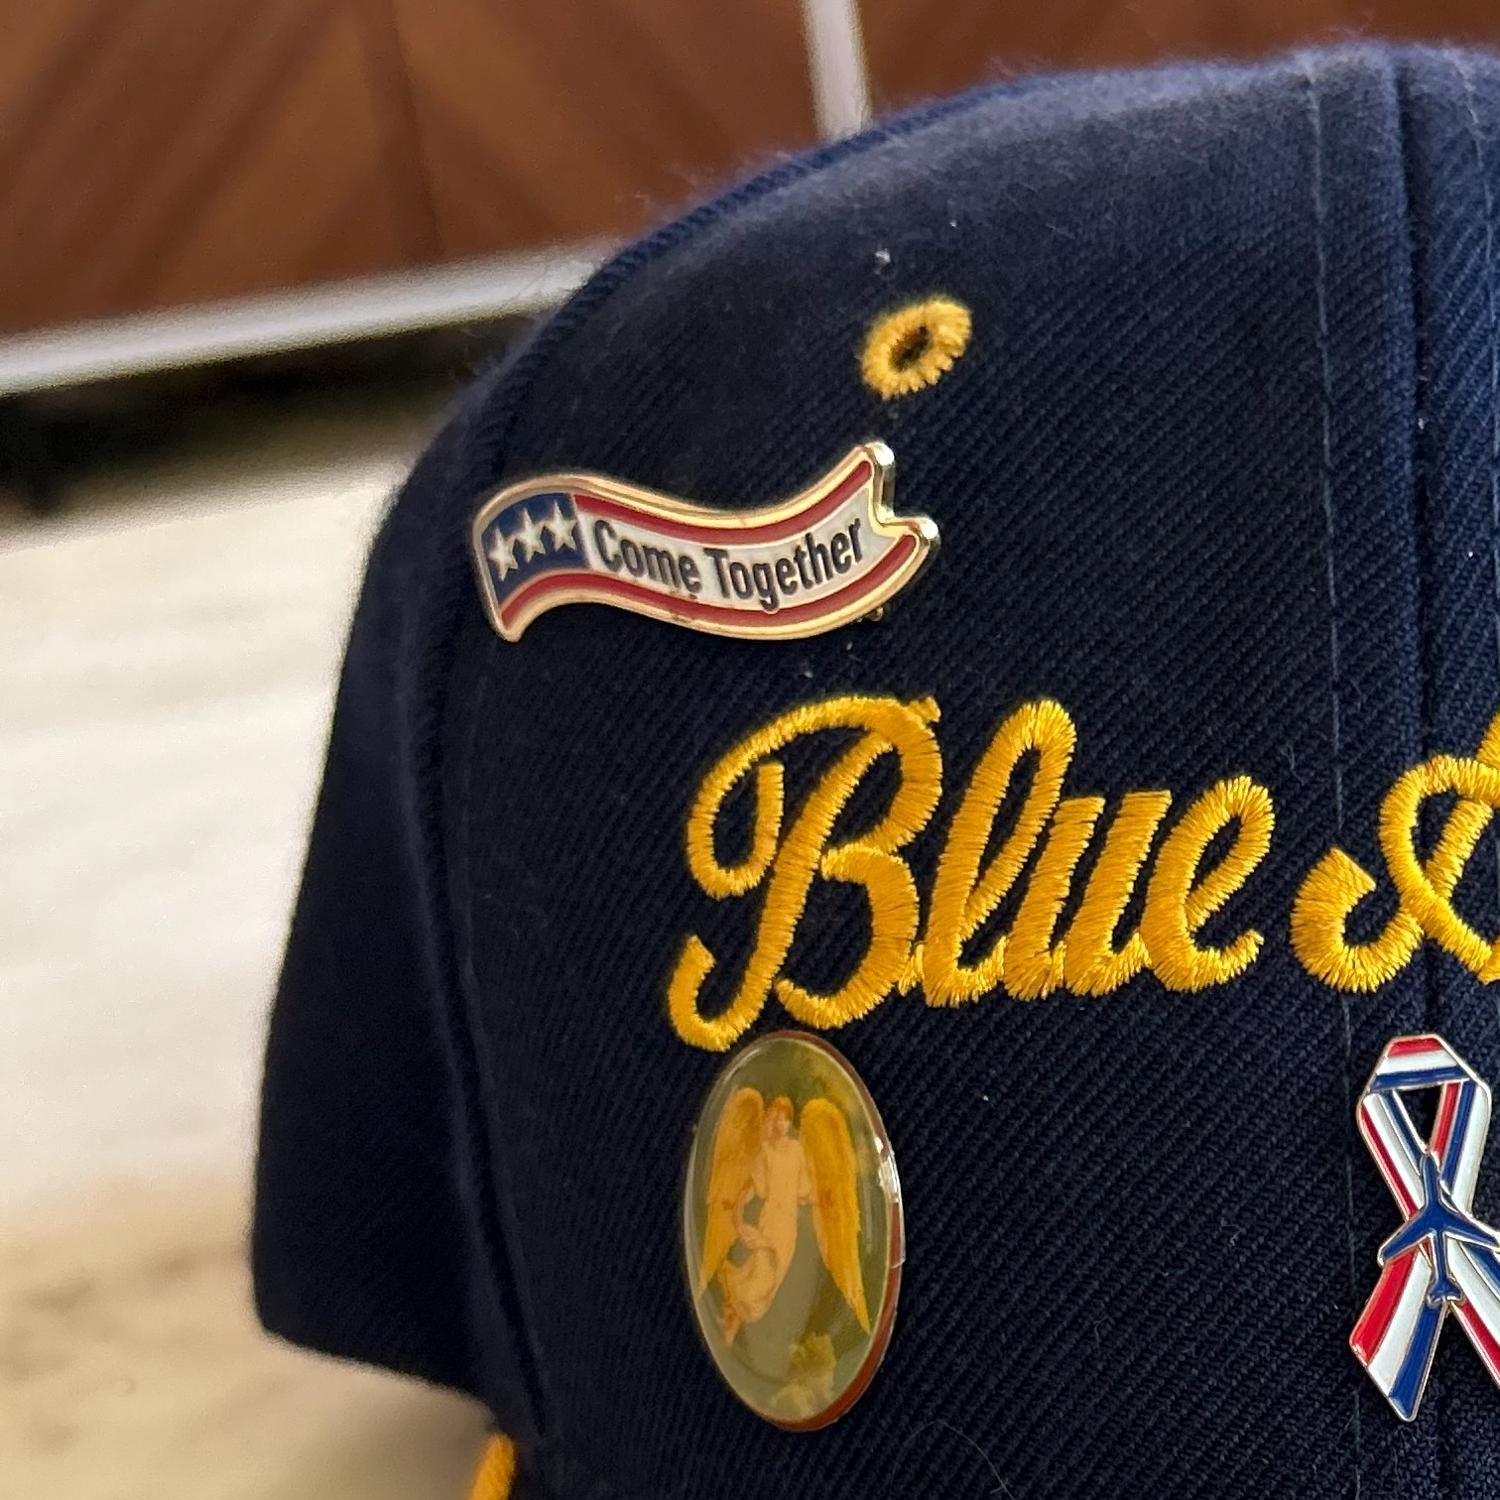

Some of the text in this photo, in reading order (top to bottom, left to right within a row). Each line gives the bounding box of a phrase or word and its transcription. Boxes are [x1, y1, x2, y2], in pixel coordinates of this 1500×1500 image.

[593, 517, 862, 612] Come Together
[667, 694, 1274, 1053] Blue
